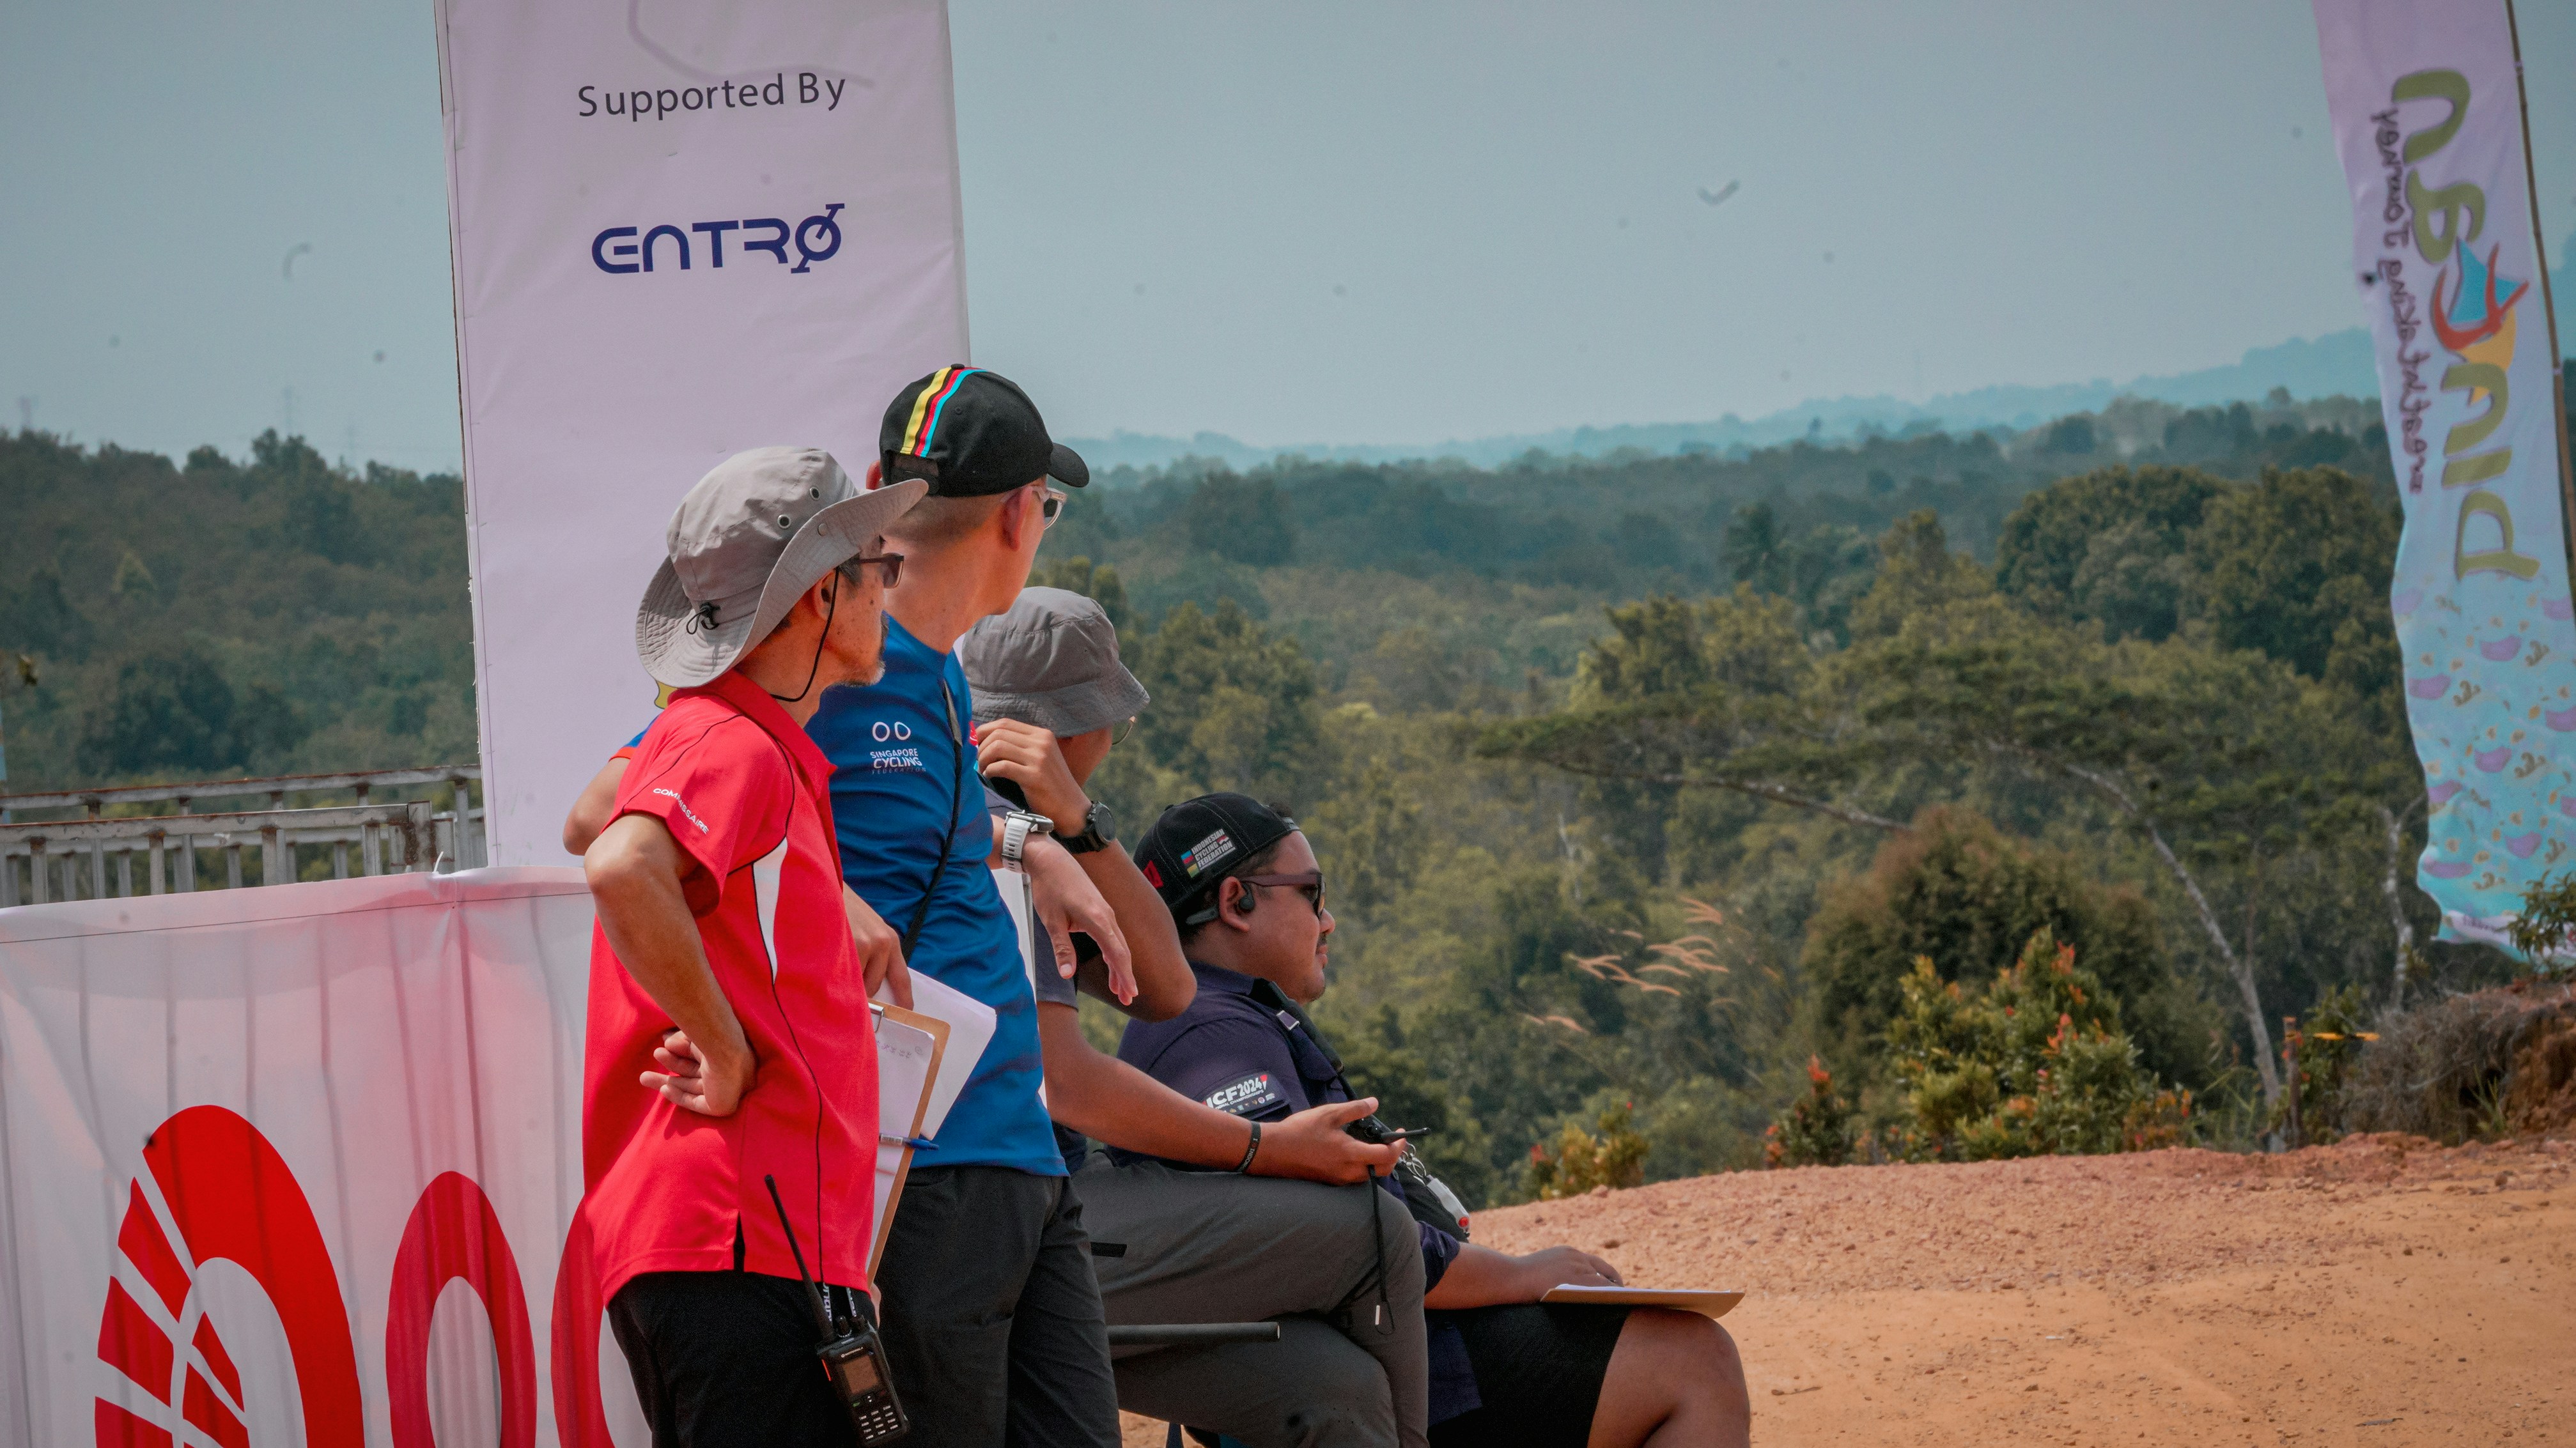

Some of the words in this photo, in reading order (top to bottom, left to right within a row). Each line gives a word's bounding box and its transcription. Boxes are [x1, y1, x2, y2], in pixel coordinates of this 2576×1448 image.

[578, 73, 785, 122] Supported
[798, 72, 846, 111] By
[870, 748, 919, 759] SINGAPORE
[873, 757, 922, 769] CYCLING
[653, 788, 709, 835] COMMISSAIRE
[1191, 829, 1225, 855] INDONESIAN
[1195, 841, 1219, 861] CYCLING
[1197, 840, 1233, 868] FEDERATION
